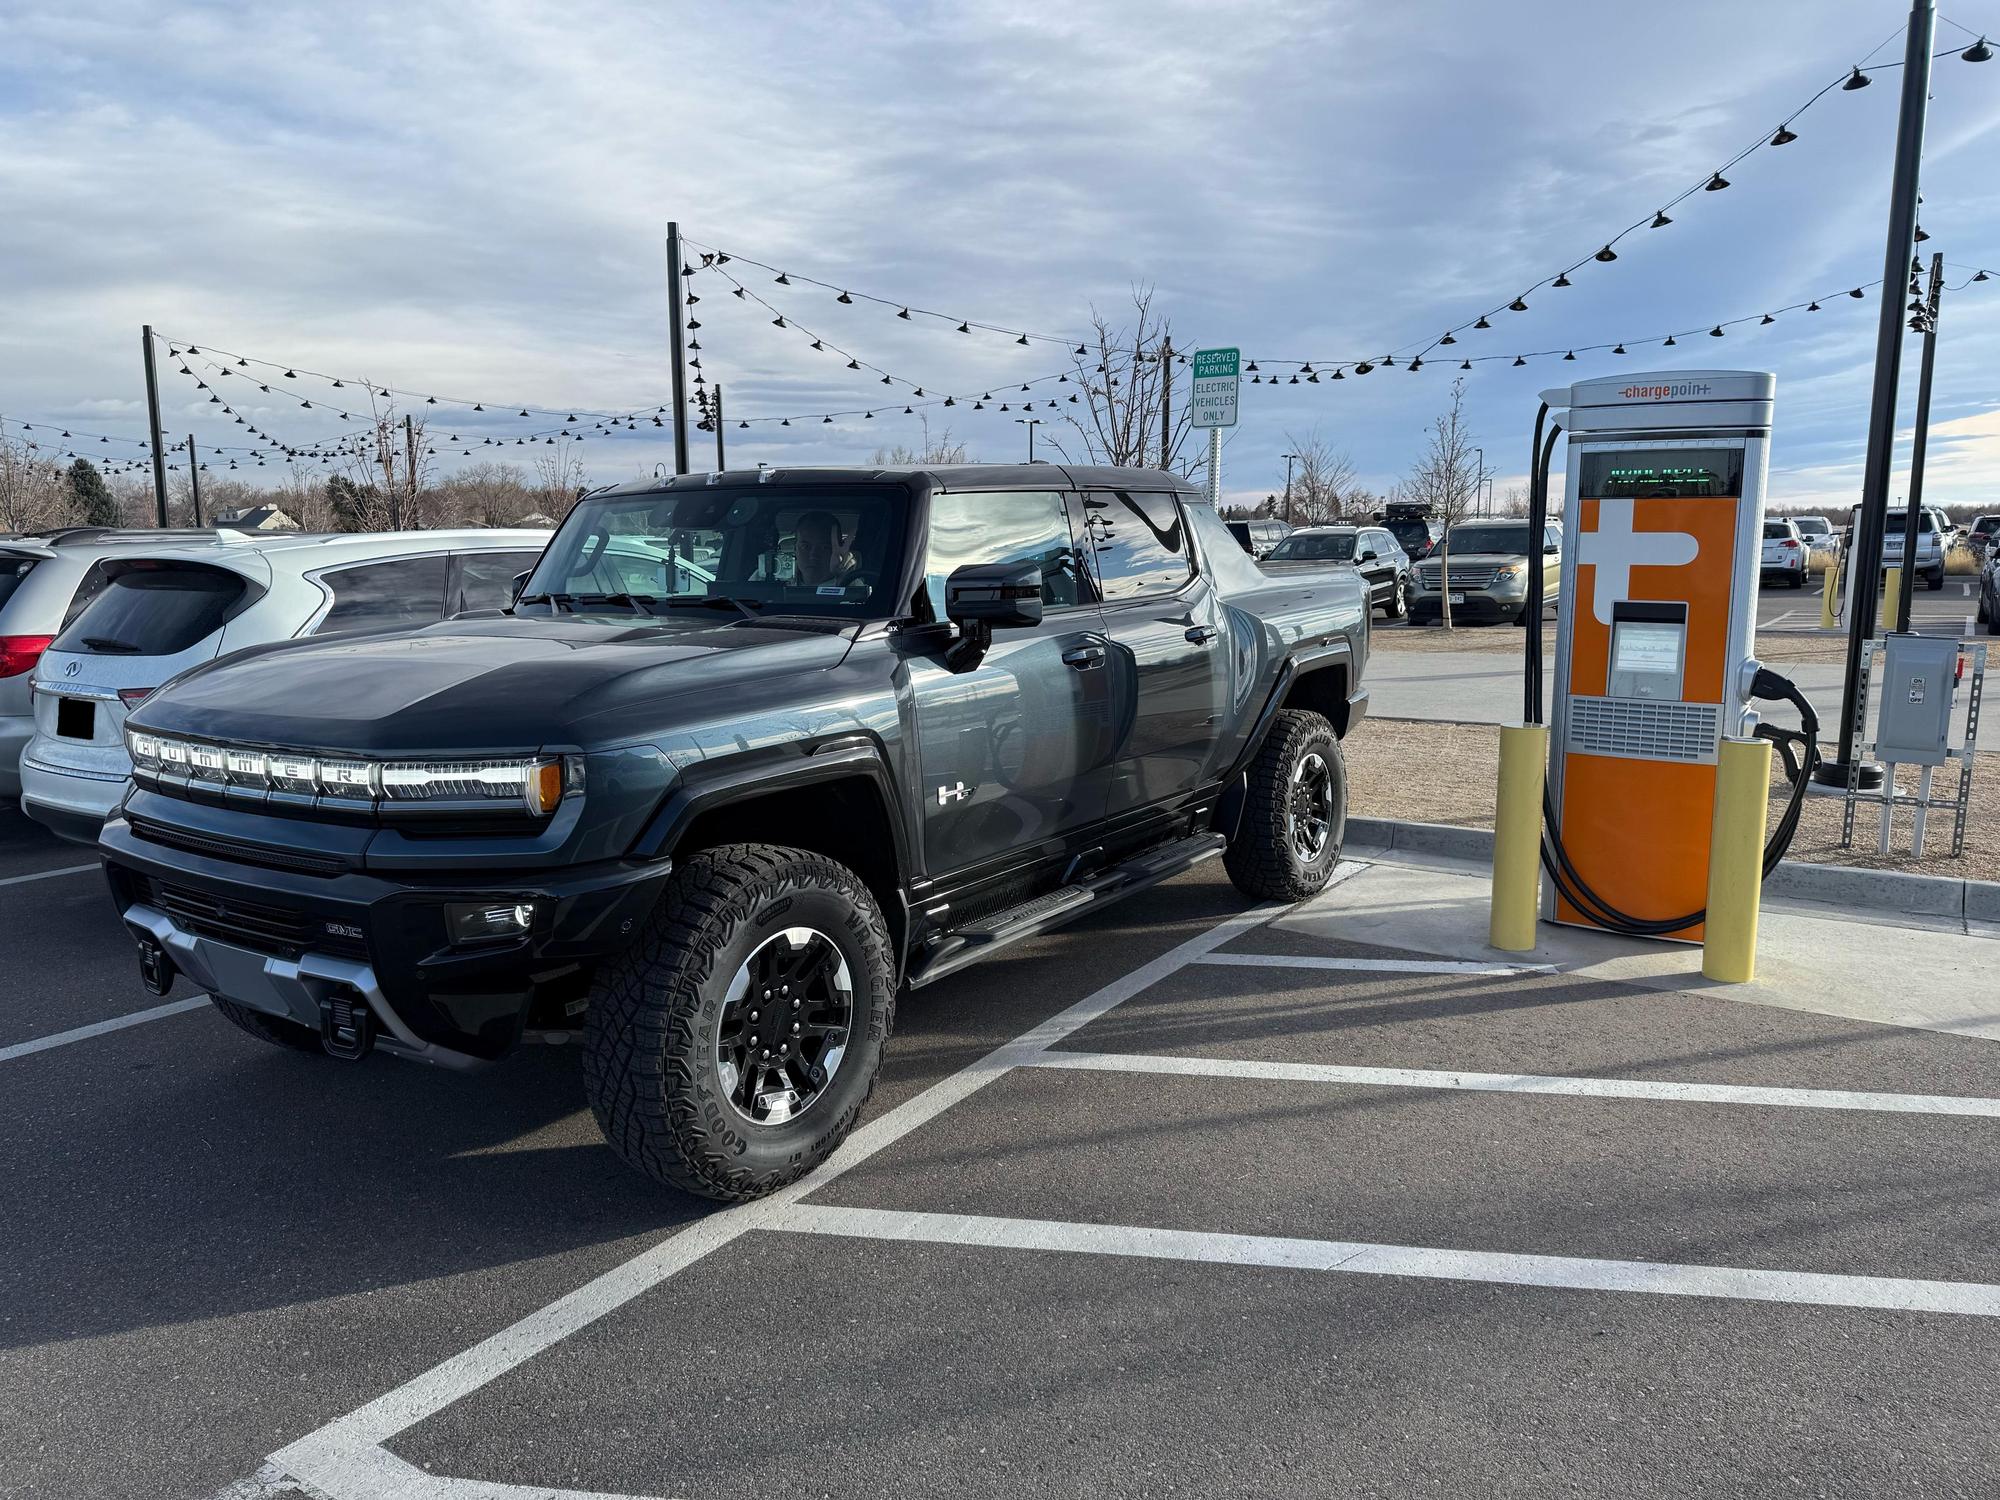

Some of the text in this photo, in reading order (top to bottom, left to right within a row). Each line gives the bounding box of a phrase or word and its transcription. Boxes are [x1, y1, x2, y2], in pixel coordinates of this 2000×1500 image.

[1196, 352, 1237, 365] RESERVED
[1199, 364, 1234, 375] PARKING
[1196, 382, 1235, 394] ELECTRIC
[1195, 396, 1235, 408] VEHICLES
[1203, 411, 1225, 421] ONLY
[142, 740, 353, 783] HUMMER
[326, 922, 363, 939] GMC
[844, 909, 884, 1043] WRANGLER
[697, 1000, 747, 1156] GOODYEAR
